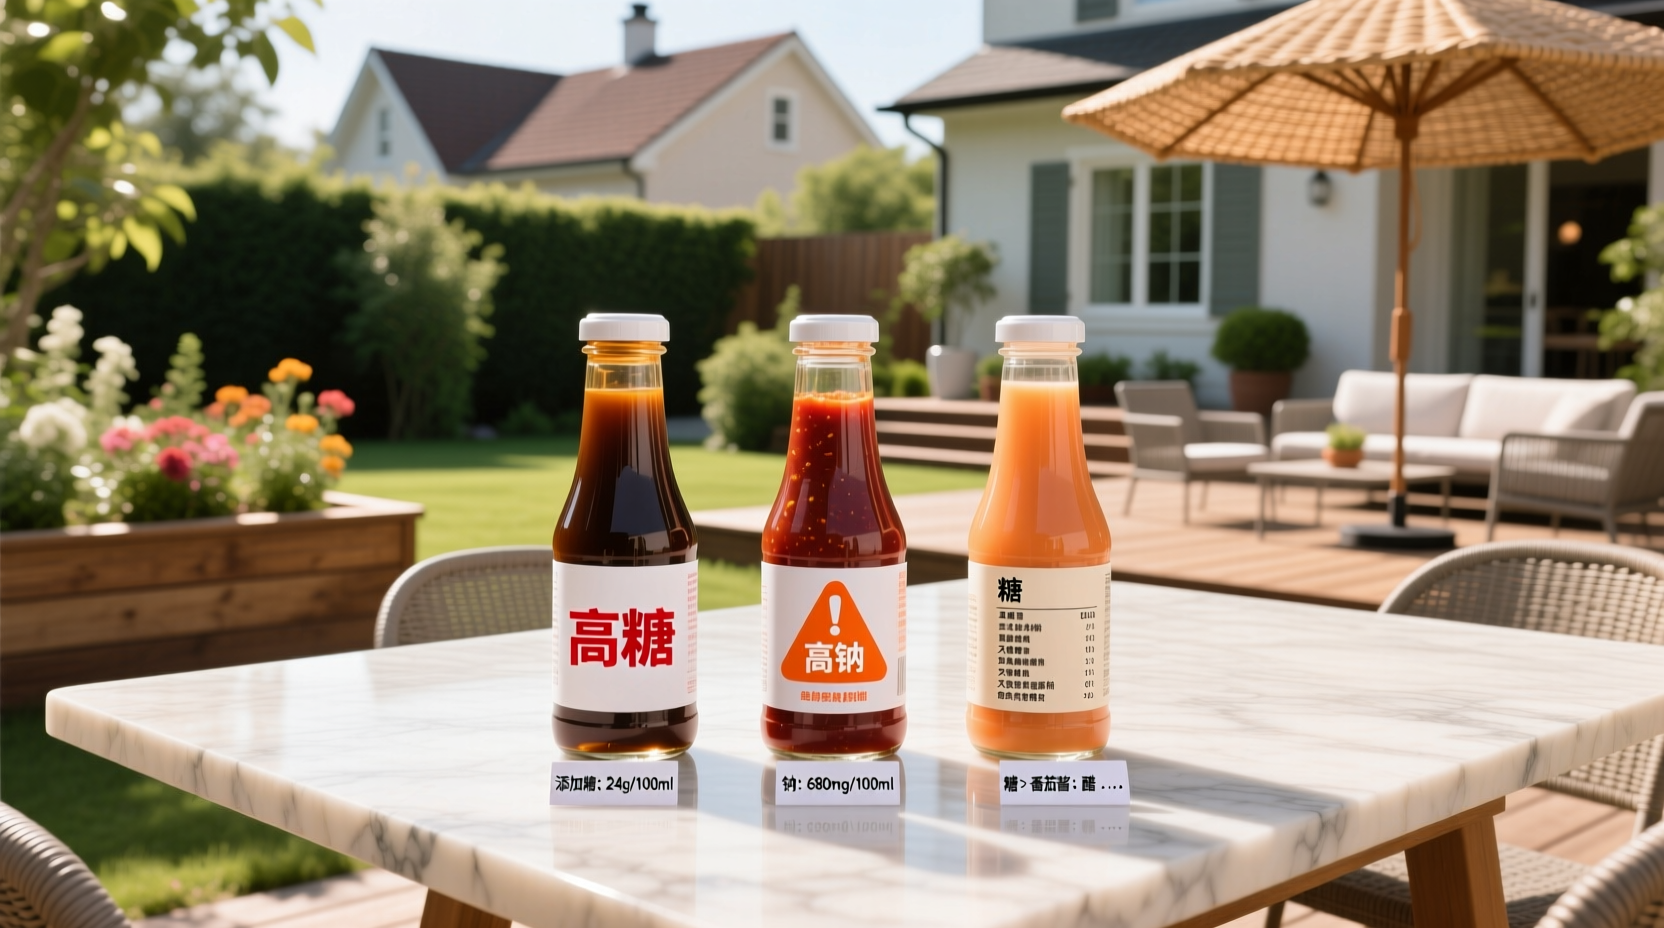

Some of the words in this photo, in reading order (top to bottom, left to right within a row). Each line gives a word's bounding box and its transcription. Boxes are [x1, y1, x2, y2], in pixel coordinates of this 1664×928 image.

[997, 576, 1023, 603] 糖
[569, 607, 676, 668] 高糖
[804, 641, 865, 674] 高钠
[605, 776, 674, 794] 24g/100ml
